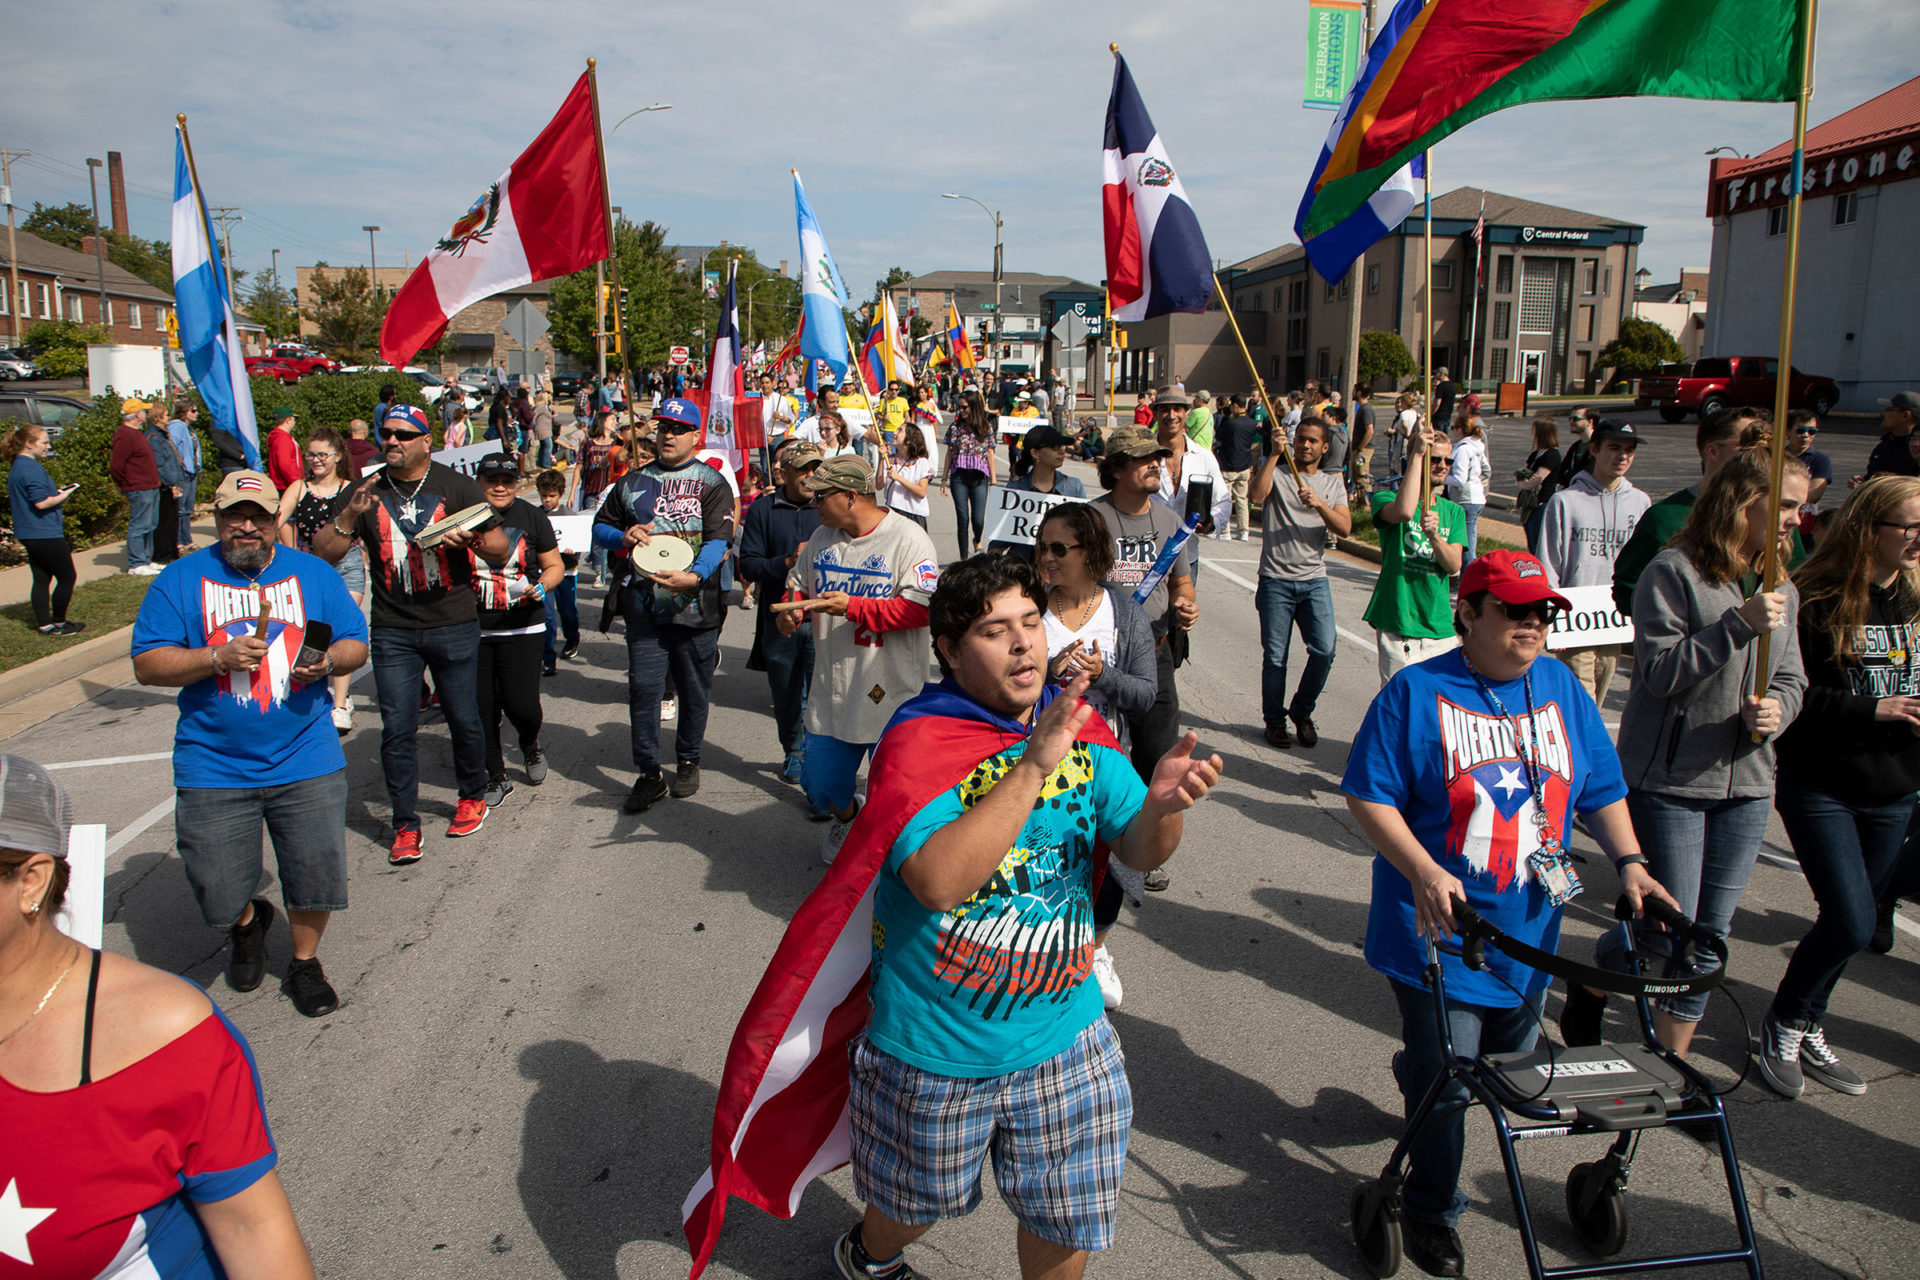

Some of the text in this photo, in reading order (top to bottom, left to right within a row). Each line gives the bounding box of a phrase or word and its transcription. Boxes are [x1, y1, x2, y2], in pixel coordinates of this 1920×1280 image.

[1314, 12, 1330, 97] CELEBRATION
[1326, 13, 1343, 98] of NATIONS
[1727, 144, 1914, 212] Firestone
[1535, 230, 1589, 240] Central Federal
[1115, 537, 1158, 562] PR
[814, 562, 892, 598] Santurce
[1107, 571, 1144, 582] PUERTO
[204, 577, 304, 637] PUERTO RICO
[1440, 701, 1571, 782] PUERTO RICO
[1644, 984, 1680, 993] DOLOMITE
